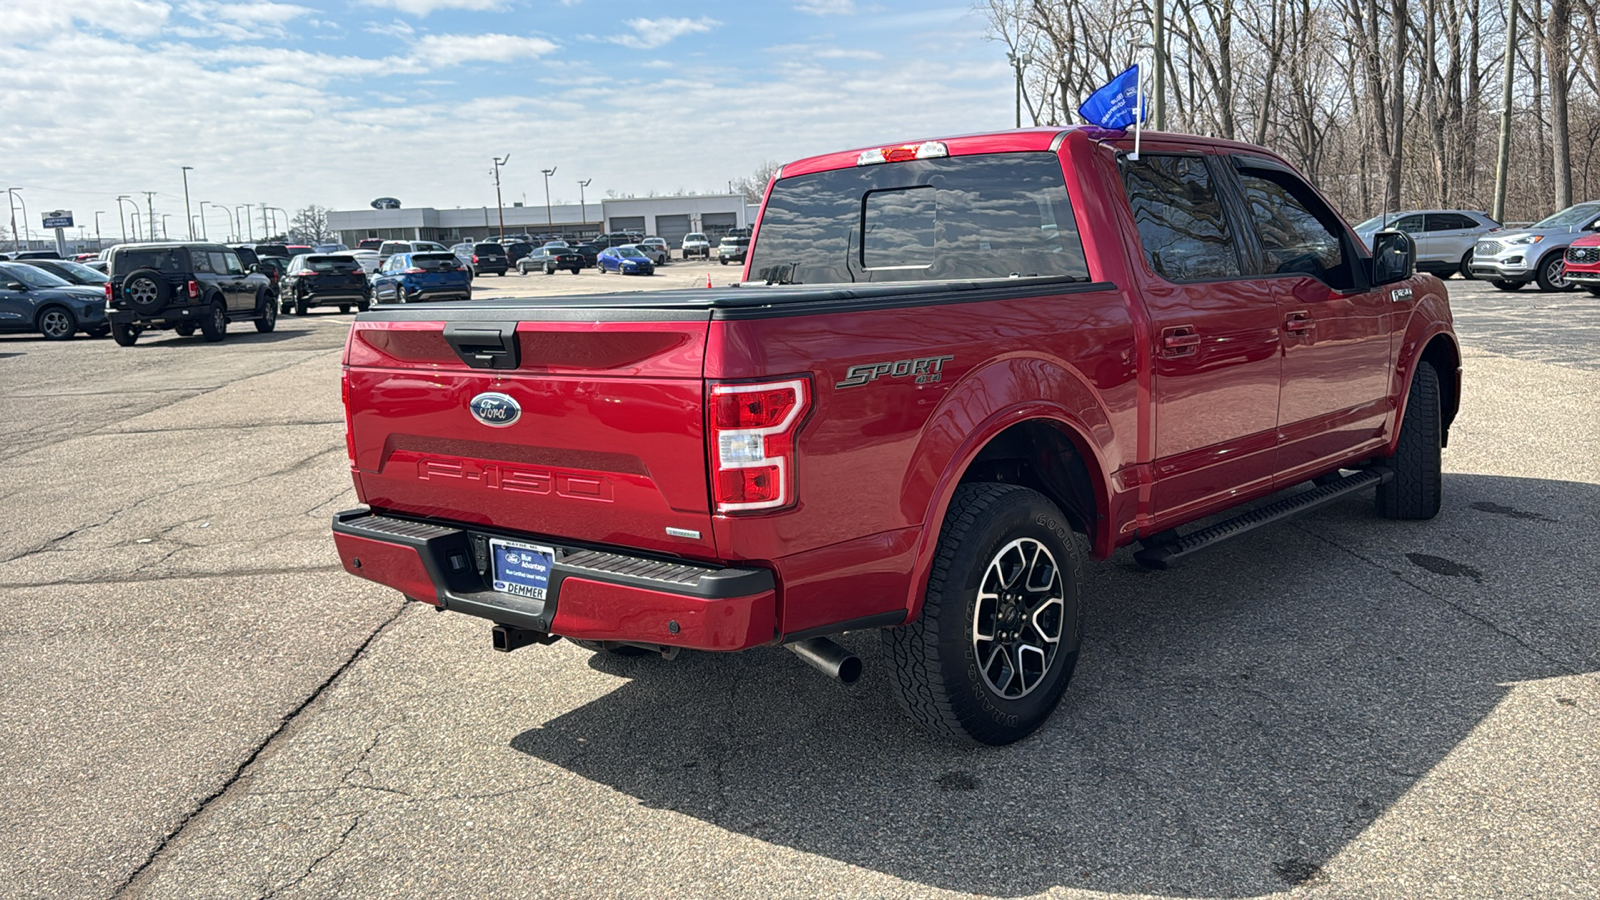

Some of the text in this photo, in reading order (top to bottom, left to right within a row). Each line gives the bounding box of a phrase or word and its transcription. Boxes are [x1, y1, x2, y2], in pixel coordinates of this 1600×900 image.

[835, 354, 954, 390] SPORT
[479, 399, 507, 419] Ford
[416, 457, 615, 503] F-150
[521, 554, 532, 562] Blue
[522, 562, 546, 572] Advantage
[1035, 512, 1083, 638] GOODYEAR
[508, 583, 543, 598] DEMMER
[964, 600, 1019, 729] WRANGLER
